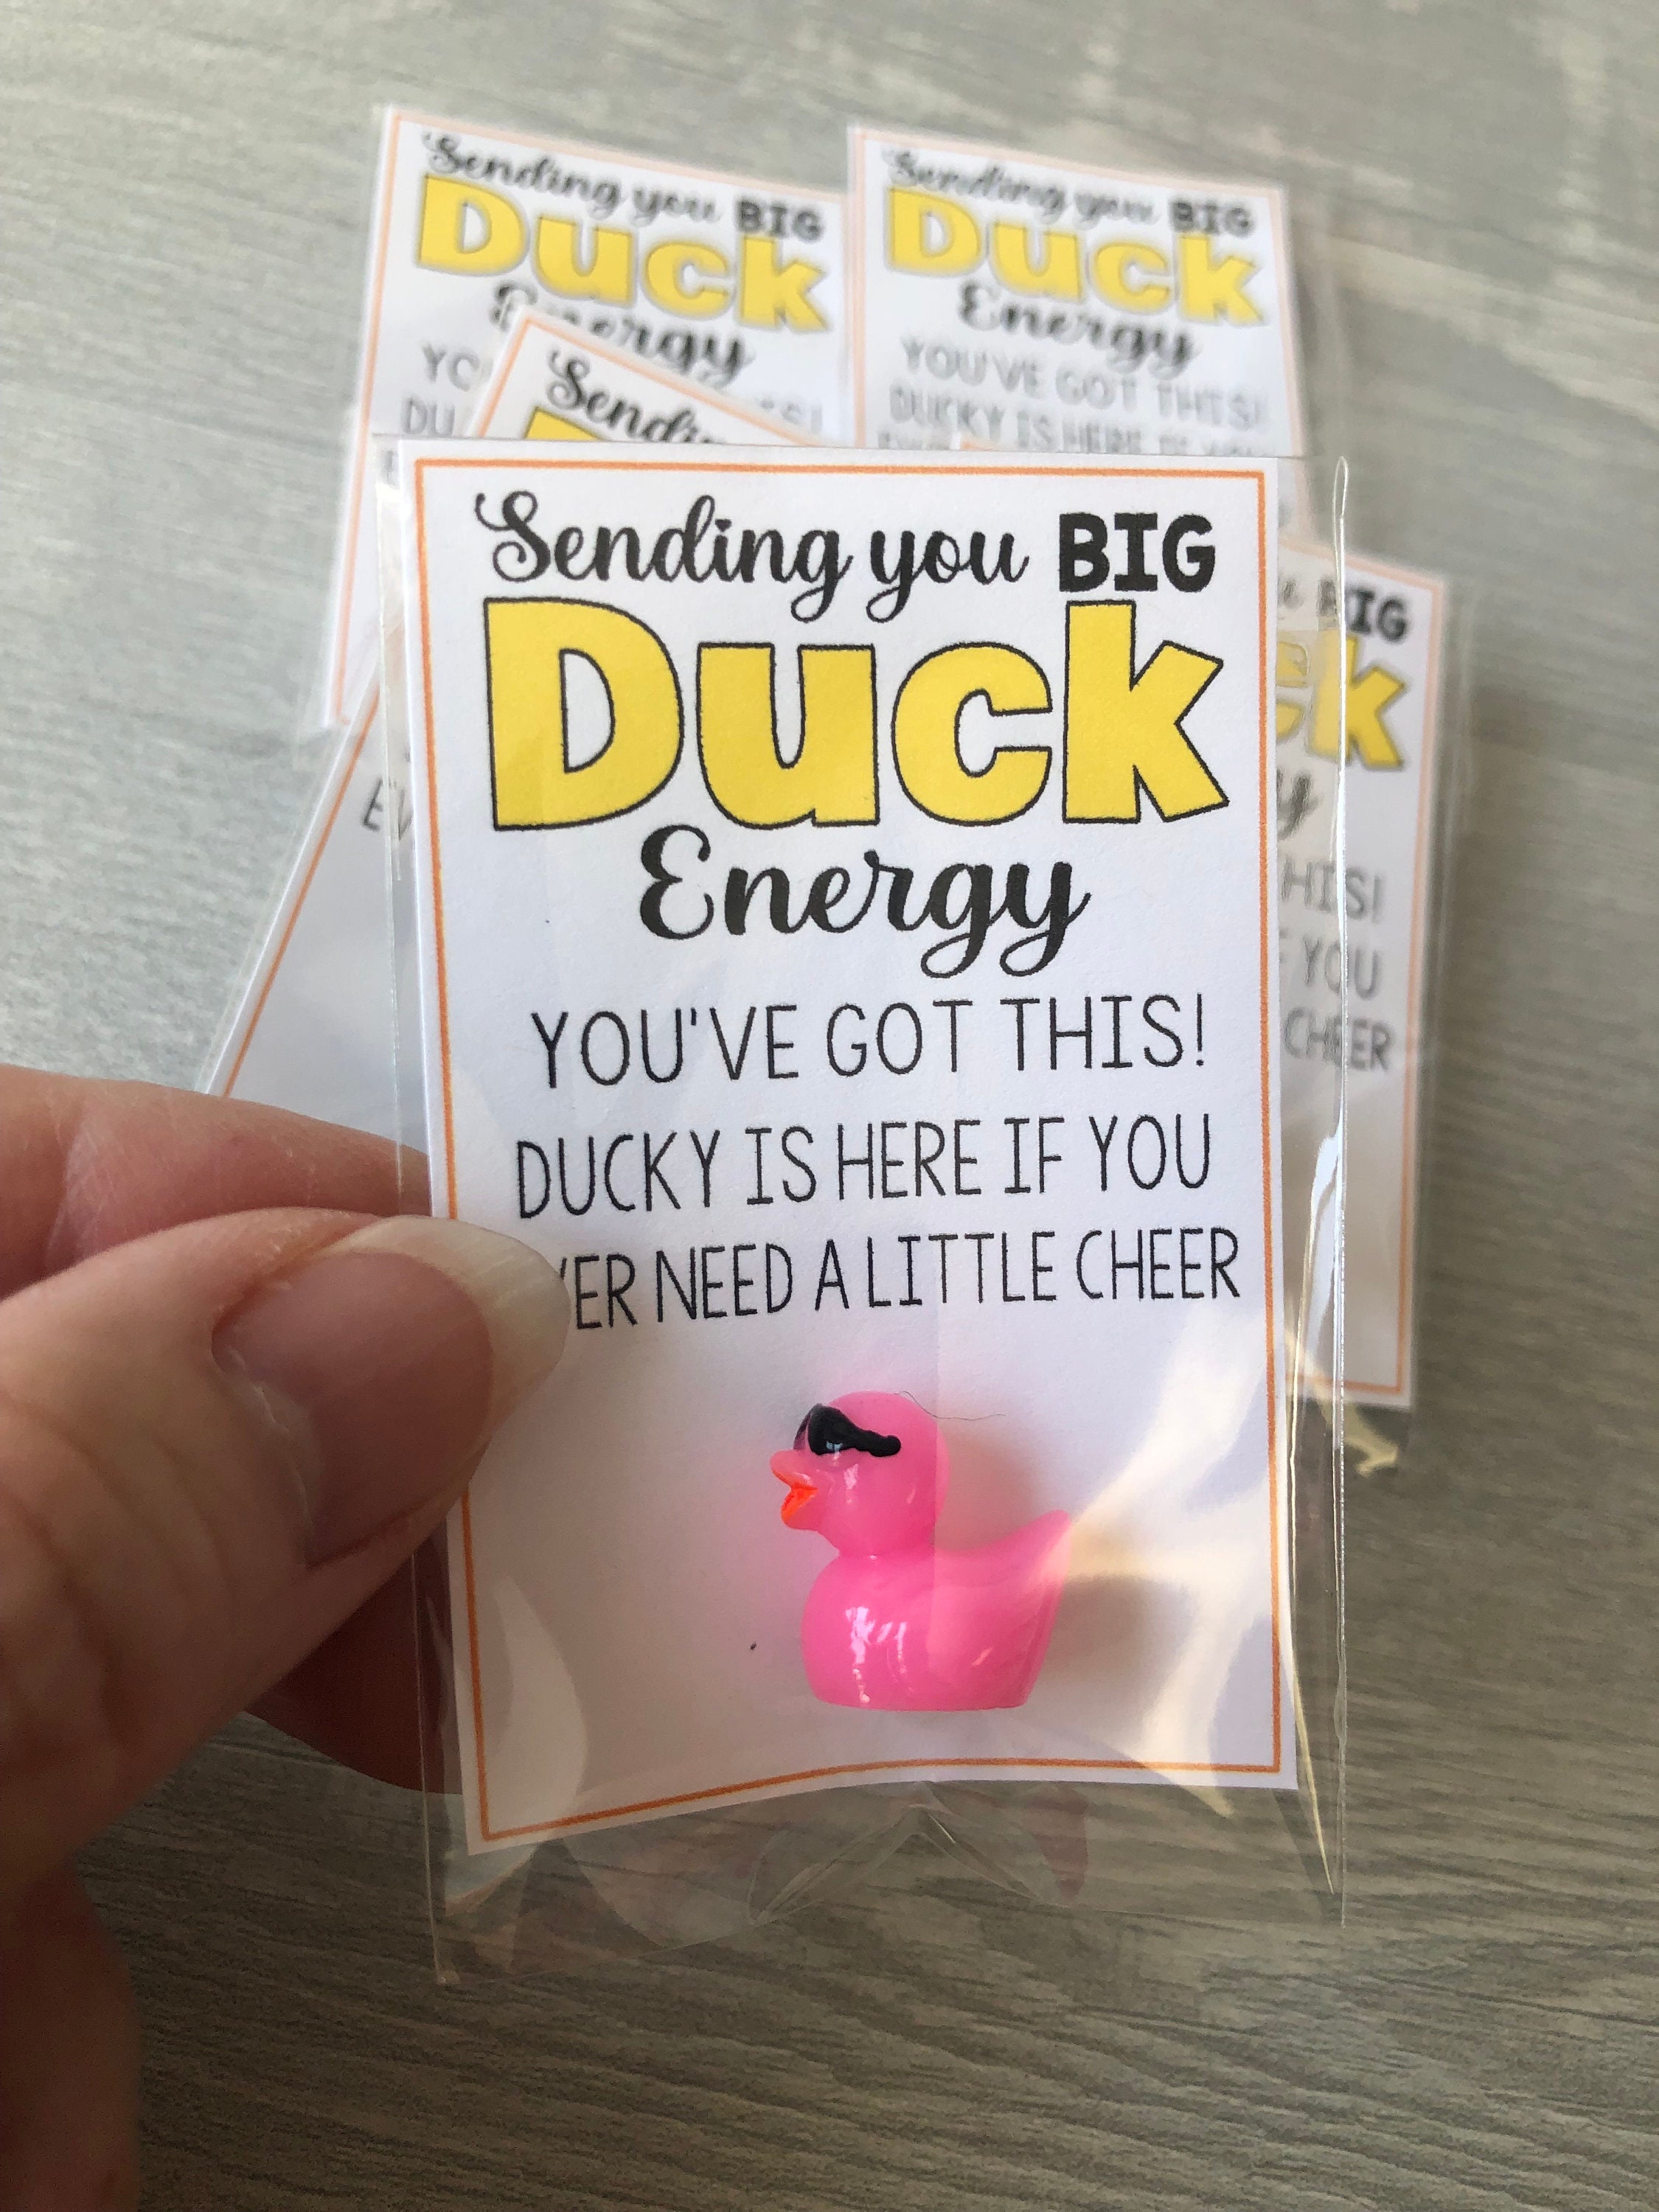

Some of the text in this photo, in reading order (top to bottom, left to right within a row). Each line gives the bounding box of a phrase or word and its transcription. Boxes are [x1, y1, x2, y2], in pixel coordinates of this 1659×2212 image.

[422, 131, 824, 243] Sending you BIG
[1168, 196, 1256, 238] BIG
[415, 174, 832, 333] Duck
[885, 187, 1267, 324] Duck
[957, 279, 1198, 380] Energy
[476, 492, 1215, 623] Sending you BIG
[484, 597, 1230, 831] Duck
[640, 825, 1091, 978] Energy
[1281, 855, 1386, 923] HIS!
[1302, 933, 1381, 1000] YOU
[532, 994, 1203, 1088] YOU'VE GOT THIS!
[1284, 1006, 1393, 1071] CHEER
[518, 1114, 1209, 1219] DUCKY IS HERE IF YOU
[559, 1228, 1239, 1330] ER NEED A LITTLE CHEER
